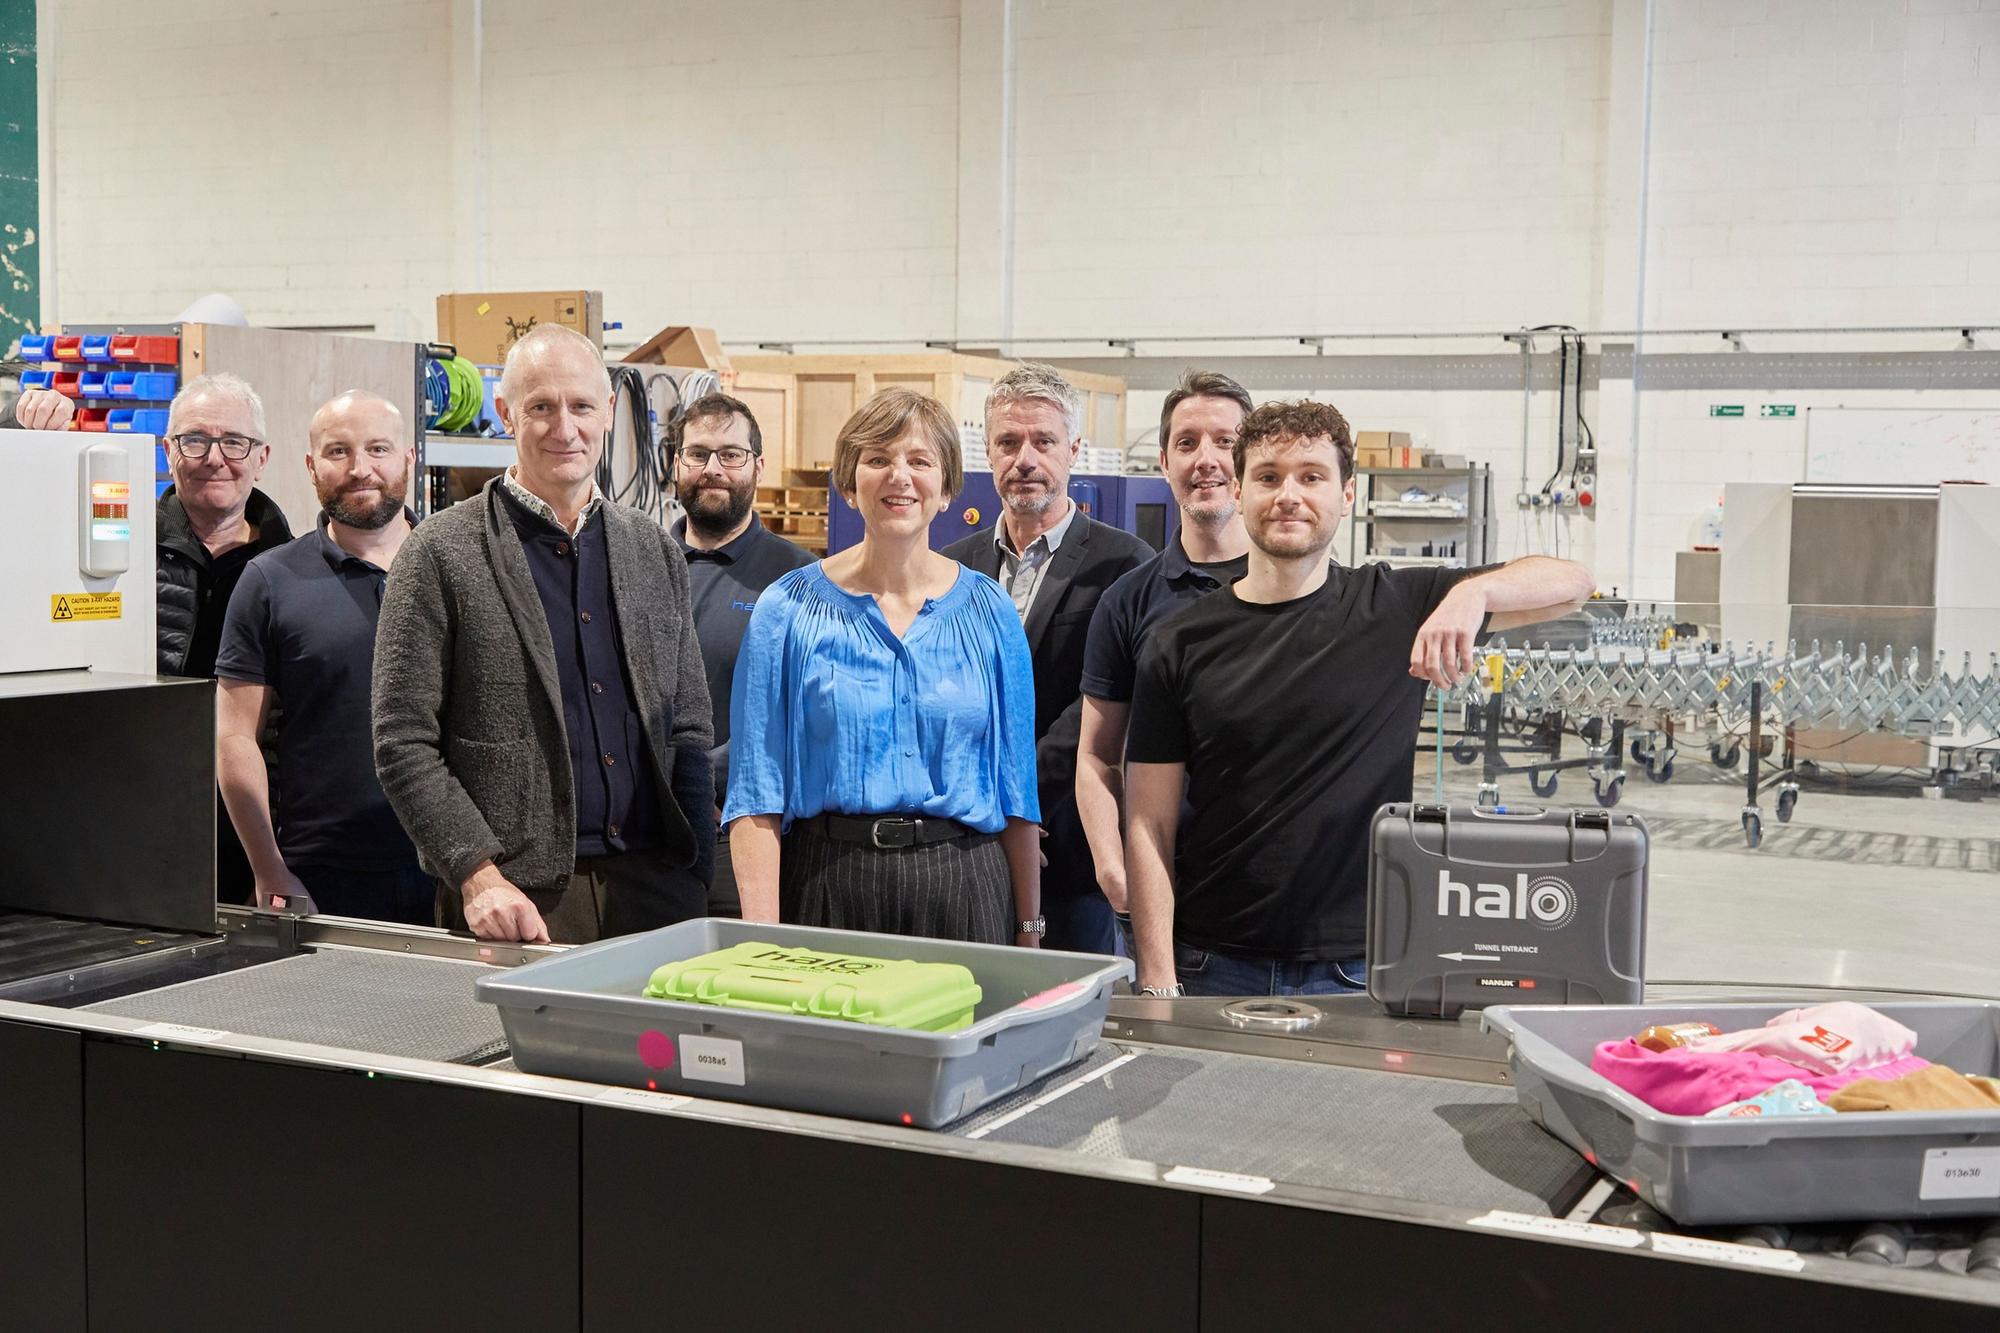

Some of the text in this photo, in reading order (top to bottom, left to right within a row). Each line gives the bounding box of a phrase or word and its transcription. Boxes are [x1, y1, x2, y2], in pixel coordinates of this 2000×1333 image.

[1438, 870, 1573, 924] halo
[1474, 943, 1539, 954] TUNNEL ENTRANCE
[752, 951, 878, 970] halo
[1481, 979, 1514, 987] NANUK
